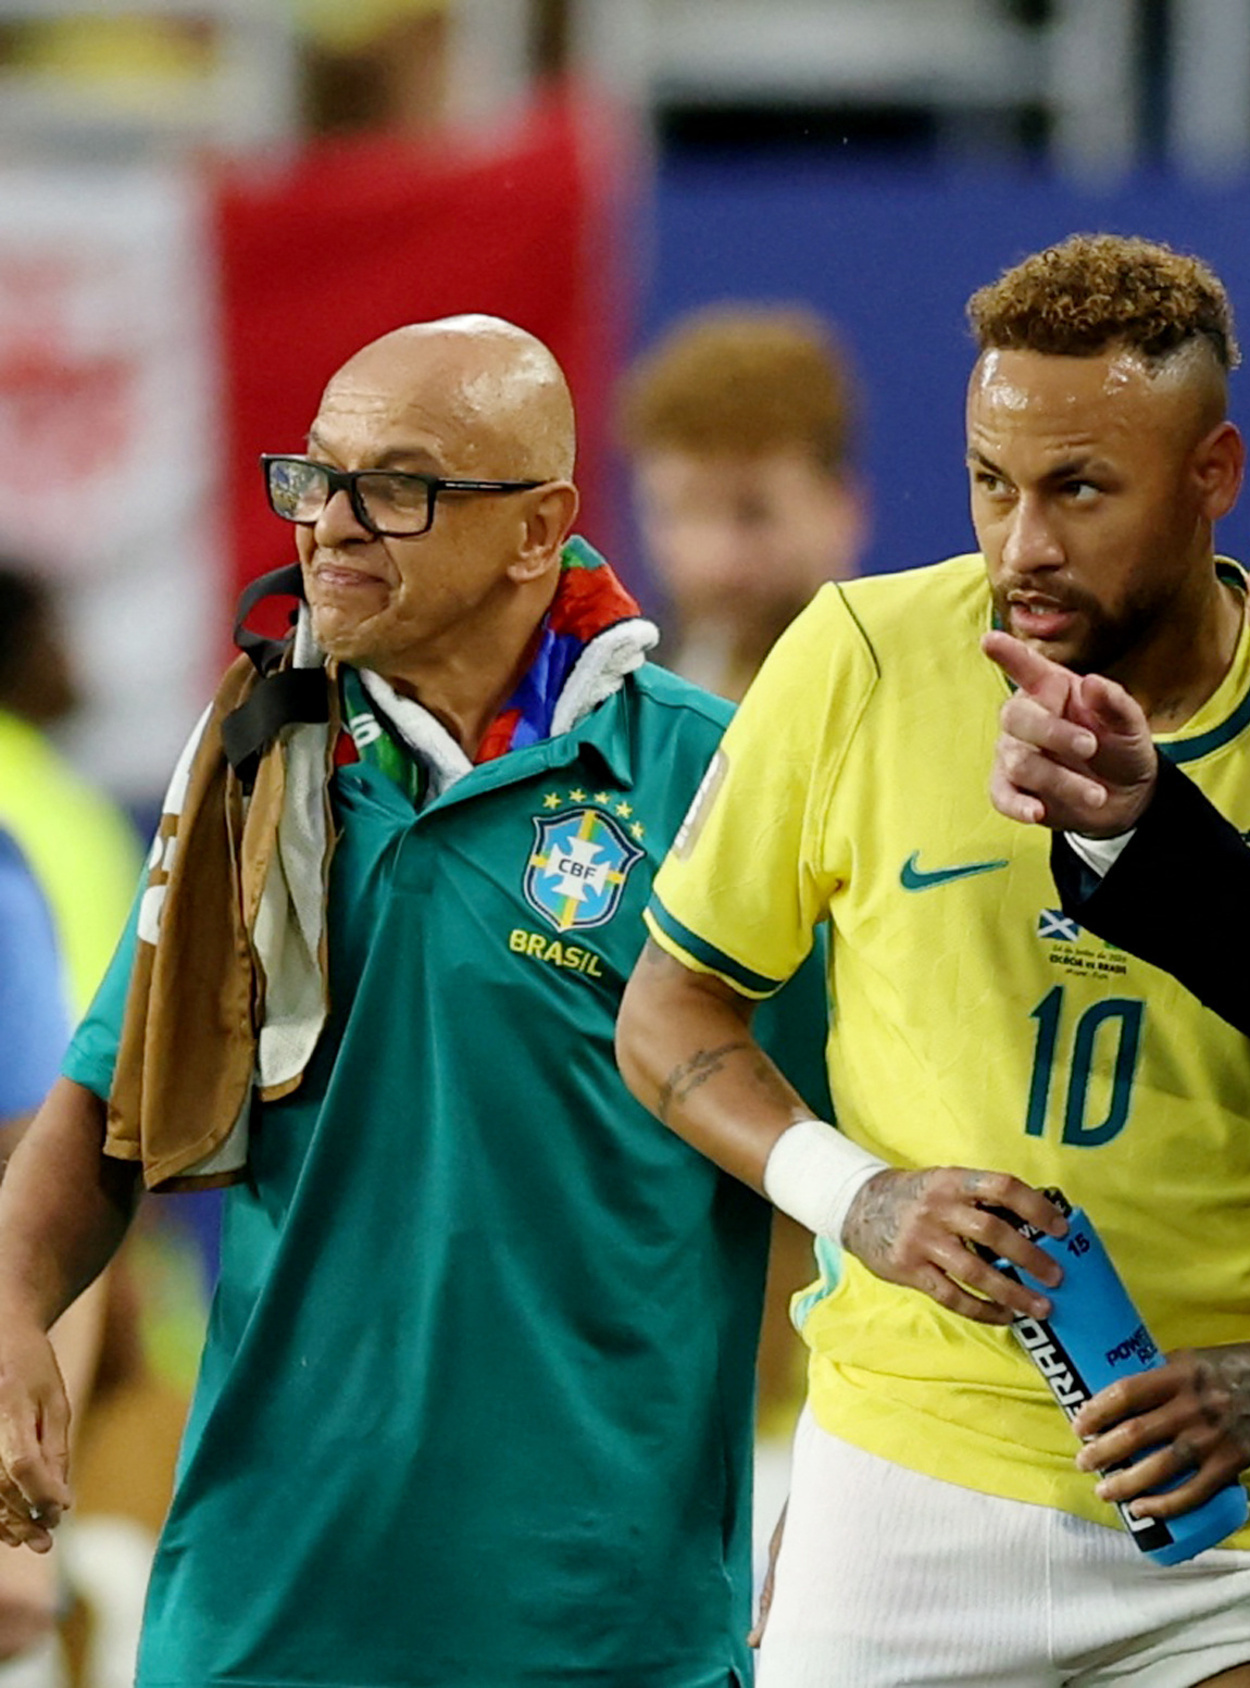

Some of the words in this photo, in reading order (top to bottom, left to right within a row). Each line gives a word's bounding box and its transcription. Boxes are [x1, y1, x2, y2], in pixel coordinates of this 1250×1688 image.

[558, 858, 598, 880] CBF
[509, 928, 603, 978] BRASIL
[1024, 984, 1146, 1148] 10
[1066, 1232, 1091, 1258] 15
